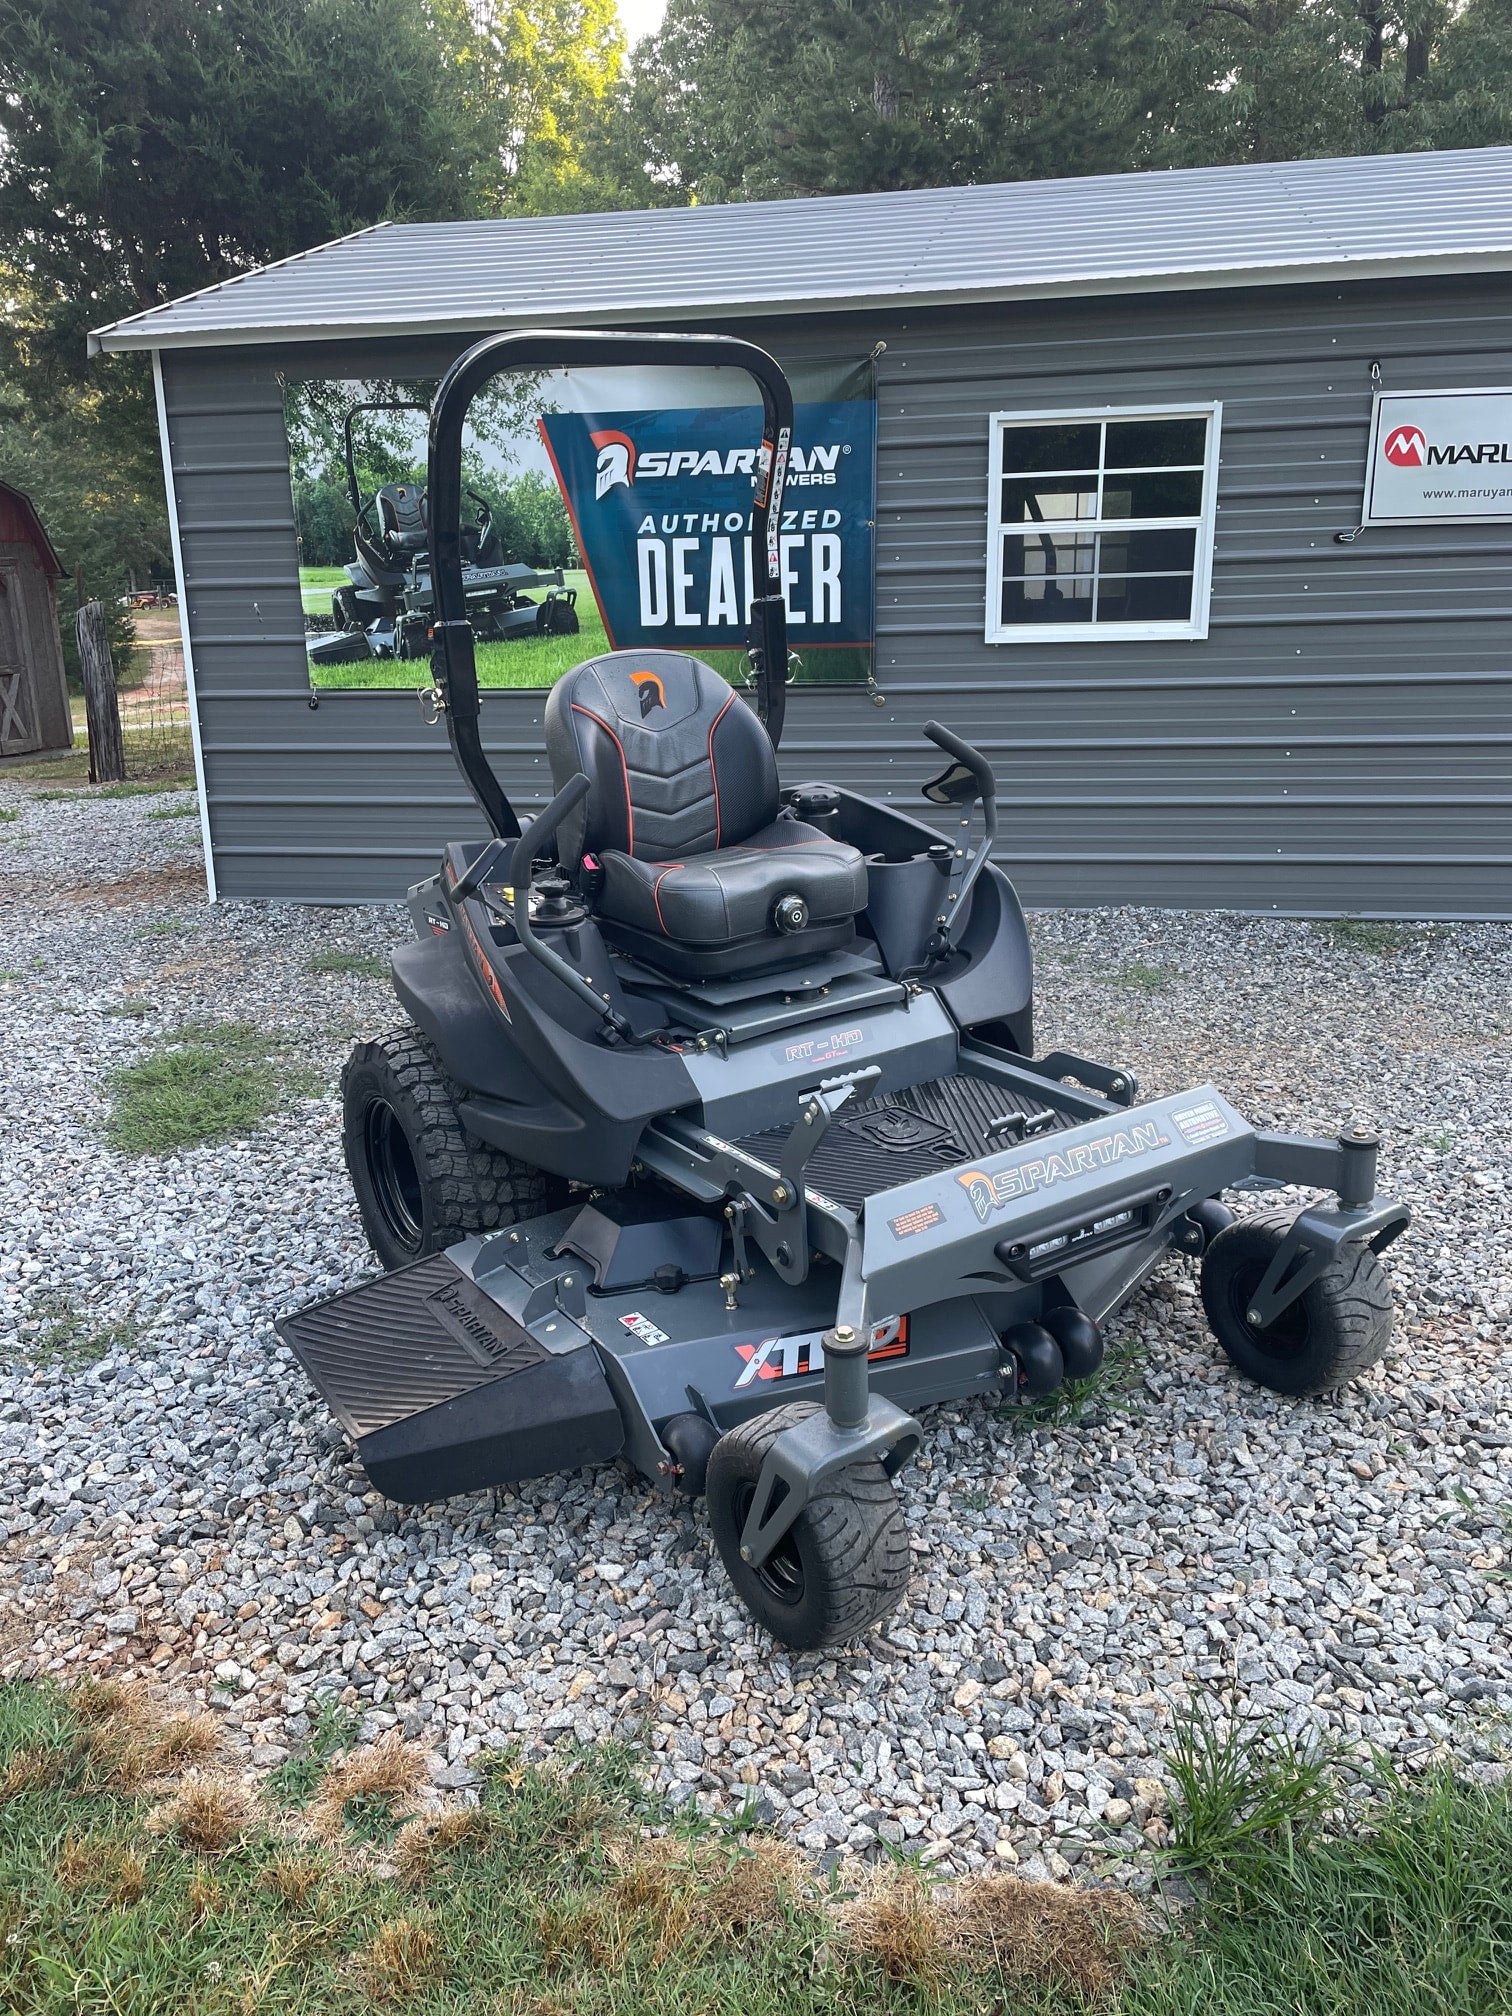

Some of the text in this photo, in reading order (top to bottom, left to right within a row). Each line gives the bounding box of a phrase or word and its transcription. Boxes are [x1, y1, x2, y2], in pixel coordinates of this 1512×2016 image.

[635, 445, 840, 478] SPARAN
[750, 472, 836, 487] MWERS
[637, 509, 841, 534] AUTHOZED
[1178, 1109, 1220, 1130] AUTOMOTIVE
[993, 1122, 1159, 1200] SPARTAN
[447, 1298, 508, 1357] SPARTAN
